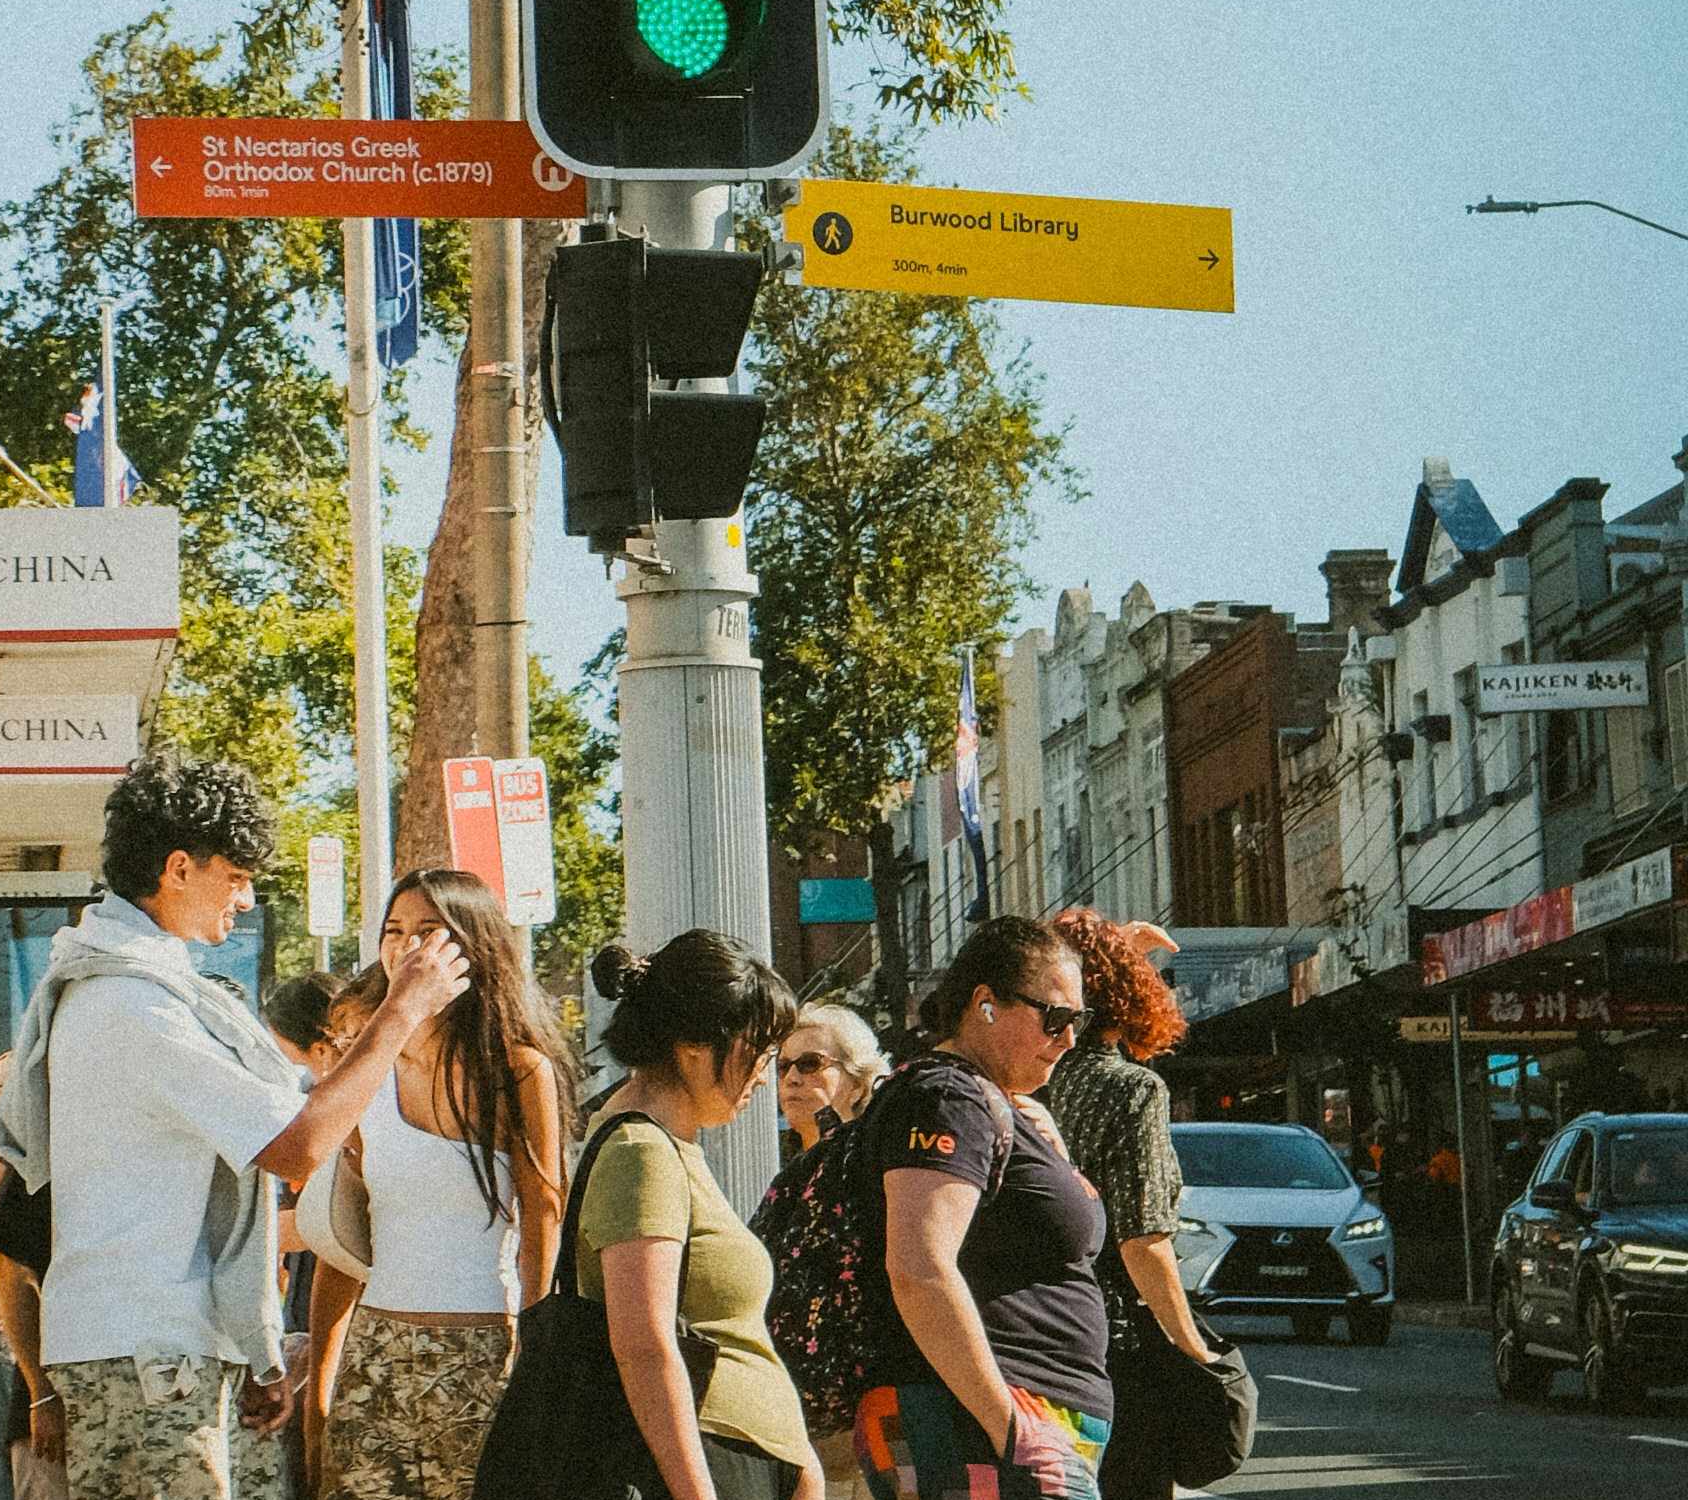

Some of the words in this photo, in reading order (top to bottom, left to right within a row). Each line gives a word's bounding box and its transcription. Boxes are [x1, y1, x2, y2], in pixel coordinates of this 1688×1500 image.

[202, 135, 227, 157] St
[234, 136, 344, 158] Nectarios
[351, 137, 421, 159] Greek
[203, 160, 315, 182] Orthodox
[322, 161, 406, 182] Church
[412, 161, 492, 186] (c.1879)
[890, 204, 992, 230] Burwood
[1000, 212, 1079, 242] Library
[892, 259, 933, 275] 300m,
[936, 262, 968, 276] 4min
[1482, 674, 1578, 692] KAJIKEN
[1, 718, 108, 741] CHINA
[502, 774, 539, 797] BUS
[501, 798, 545, 821] ZONE
